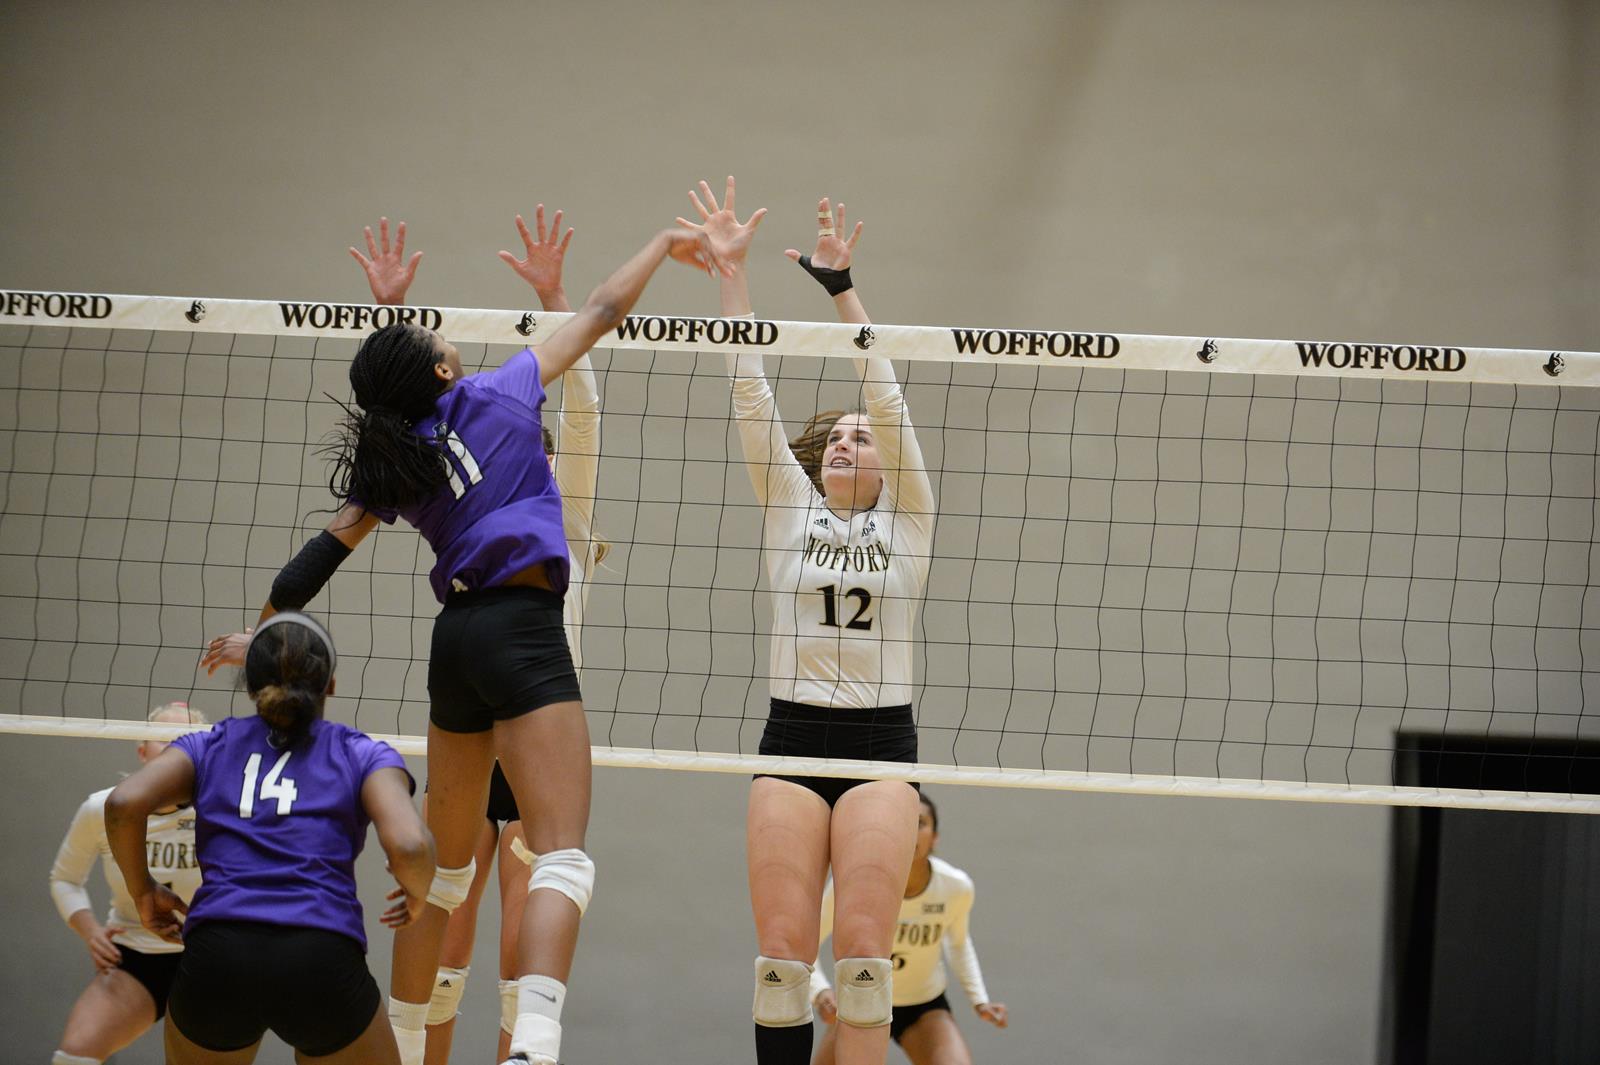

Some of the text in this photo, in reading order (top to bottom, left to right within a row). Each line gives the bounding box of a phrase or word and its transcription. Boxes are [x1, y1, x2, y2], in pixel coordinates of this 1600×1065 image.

[0, 292, 112, 319] FFORD
[279, 303, 442, 331] WOFFORD
[616, 316, 778, 346] WOFFORD
[951, 328, 1120, 359] WOFFORD
[1295, 342, 1467, 372] WOFFORD
[439, 429, 484, 500] 11
[816, 584, 873, 631] 12
[239, 751, 298, 818] 14
